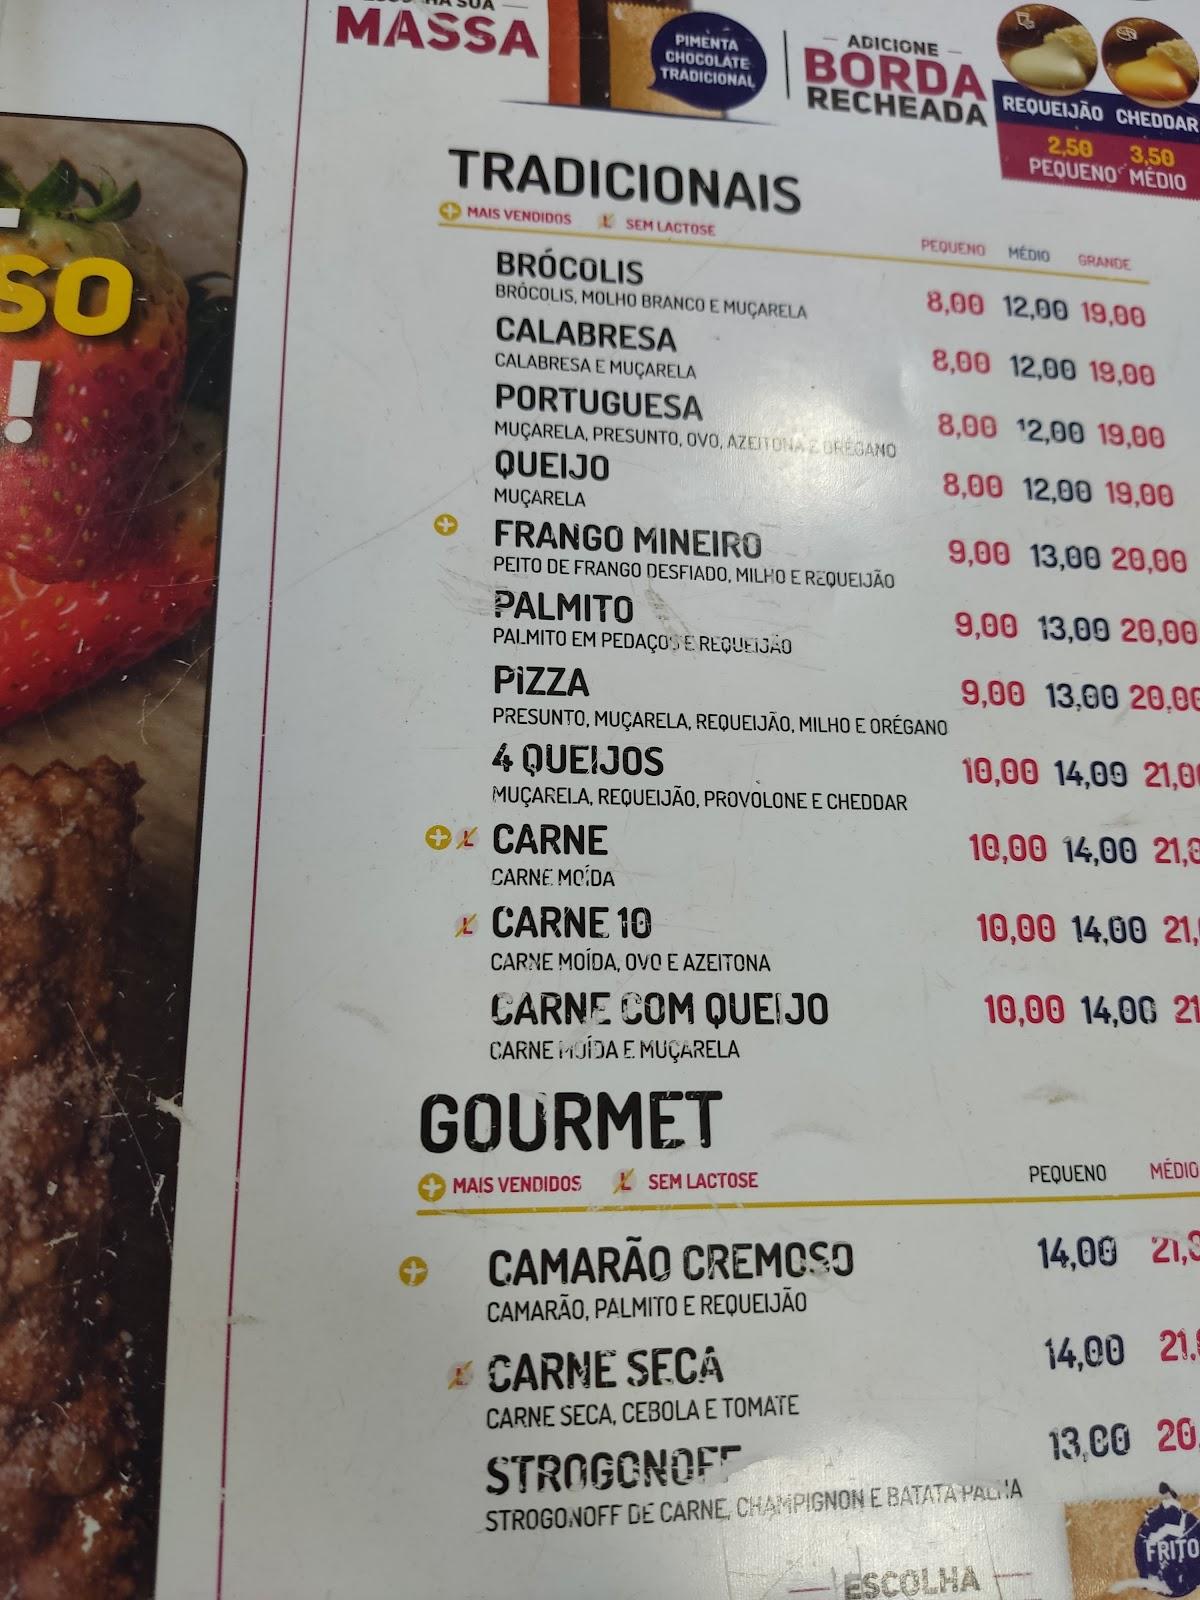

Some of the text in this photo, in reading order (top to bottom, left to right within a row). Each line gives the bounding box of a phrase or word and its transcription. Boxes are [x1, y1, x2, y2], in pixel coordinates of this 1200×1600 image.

[336, 5, 538, 57] MASSA
[675, 34, 739, 51] PIMENTA
[848, 34, 939, 57] ADICIONE
[665, 49, 751, 70] CHOCOLATE
[804, 47, 986, 100] BORDA
[661, 67, 756, 88] TRADICIONAL
[807, 86, 987, 126] RECHEADA
[1002, 95, 1104, 122] REQUEIJÃO
[1116, 109, 1200, 134] CHEDDAR
[1048, 136, 1094, 158] 2,50
[1130, 146, 1175, 169] 3,50
[448, 148, 801, 215] TRADICIONAIS
[1029, 158, 1117, 184] PEQUENO
[1129, 168, 1187, 192] MÉDIO
[468, 206, 571, 224] MAIS VENDIDOS
[626, 219, 715, 236] SEM LACTOSE
[922, 239, 985, 256] PEQUENO
[1008, 245, 1050, 262] MÉDIO
[1079, 255, 1130, 270] GRANDE
[497, 248, 644, 286] BRÓCOLIS
[496, 282, 807, 320] BRÓCOLIS, MOLHO BRANCO E MUÇARELA
[927, 291, 1146, 327] 8,00 12,00 19,00
[496, 315, 677, 353] CALABRESA
[495, 352, 696, 380] CALABRESA E MUÇARELA
[933, 349, 1155, 386] 8,00 12,00 19,00
[496, 383, 703, 421] PORTUGUESA
[495, 420, 588, 442] MUÇARELA,
[593, 426, 682, 448] PRESUNTO,
[687, 432, 722, 450] OVO,
[938, 413, 997, 439] 8,00
[1098, 423, 1165, 449] 19,00
[495, 449, 609, 481] QUEIJO
[494, 488, 586, 508] MUÇARELA
[943, 472, 1174, 508] 8,00 12,00 19,00
[495, 519, 761, 559] FRANGO MINEIRO
[494, 556, 542, 573] PEITO
[548, 558, 570, 574] DE
[575, 560, 641, 578] FRANGO
[647, 563, 731, 583] DESFIADO,
[736, 568, 786, 584] MILHO
[791, 570, 801, 585] E
[948, 540, 1187, 574] 9,00 13,00 20,00
[495, 590, 633, 624] PALMITO
[494, 626, 566, 646] PALMITO
[572, 631, 596, 647] EM
[955, 612, 1198, 646] 9,00 13,00 20,00
[961, 680, 1025, 708] 9,00
[1045, 683, 1119, 712] 13,00
[493, 707, 948, 736] PRESUNTO, MUÇARELA, REQUEIJÃO, MILHO E ORÉGANO
[492, 743, 664, 777] 4 QUEIJOS
[962, 757, 1200, 791] 10,00 14,00 21,0
[493, 785, 908, 811] MUÇARELA, REQUEIJÃO, PROVOLONE E CHEDDAR
[493, 823, 608, 855] CARNE
[969, 834, 1047, 864] 10,00
[1063, 836, 1138, 867] 14,00
[491, 868, 553, 886] CARNE
[492, 906, 652, 939] CARNE 10
[977, 913, 1200, 946] 10,00 14,00 21,
[491, 948, 771, 973] CARNE MOÍDA, OVO E AZEITONA
[491, 992, 828, 1030] CARNE COM QUEIJO
[984, 994, 1065, 1028] 10,00
[1080, 995, 1158, 1028] 14,00
[490, 1040, 554, 1060] CARNE
[624, 1040, 635, 1059] E
[640, 1040, 740, 1063] MUÇARELA
[420, 1090, 723, 1154] GOURMET
[453, 1175, 582, 1194] MAIS VENDIDOS
[649, 1172, 759, 1190] SEM LACTOSE
[1029, 1164, 1106, 1184] PEQUENO
[1150, 1158, 1199, 1180] MÉDIO
[489, 1236, 854, 1287] CAMARÃO CREMOSO
[1037, 1235, 1118, 1272] 14,00
[487, 1287, 807, 1323] CAMARÃO, PALMITO E REQUEIJÃO
[1044, 1334, 1125, 1372] 14,00
[488, 1346, 724, 1393] CARNE SECA
[486, 1394, 800, 1429] CARNE SECA, CEBOLA E TOMATE
[1049, 1423, 1130, 1462] 13,00
[485, 1504, 623, 1532] STROGONOFF
[628, 1502, 655, 1524] DE
[660, 1498, 730, 1523] CARNE,
[870, 1487, 883, 1509] E
